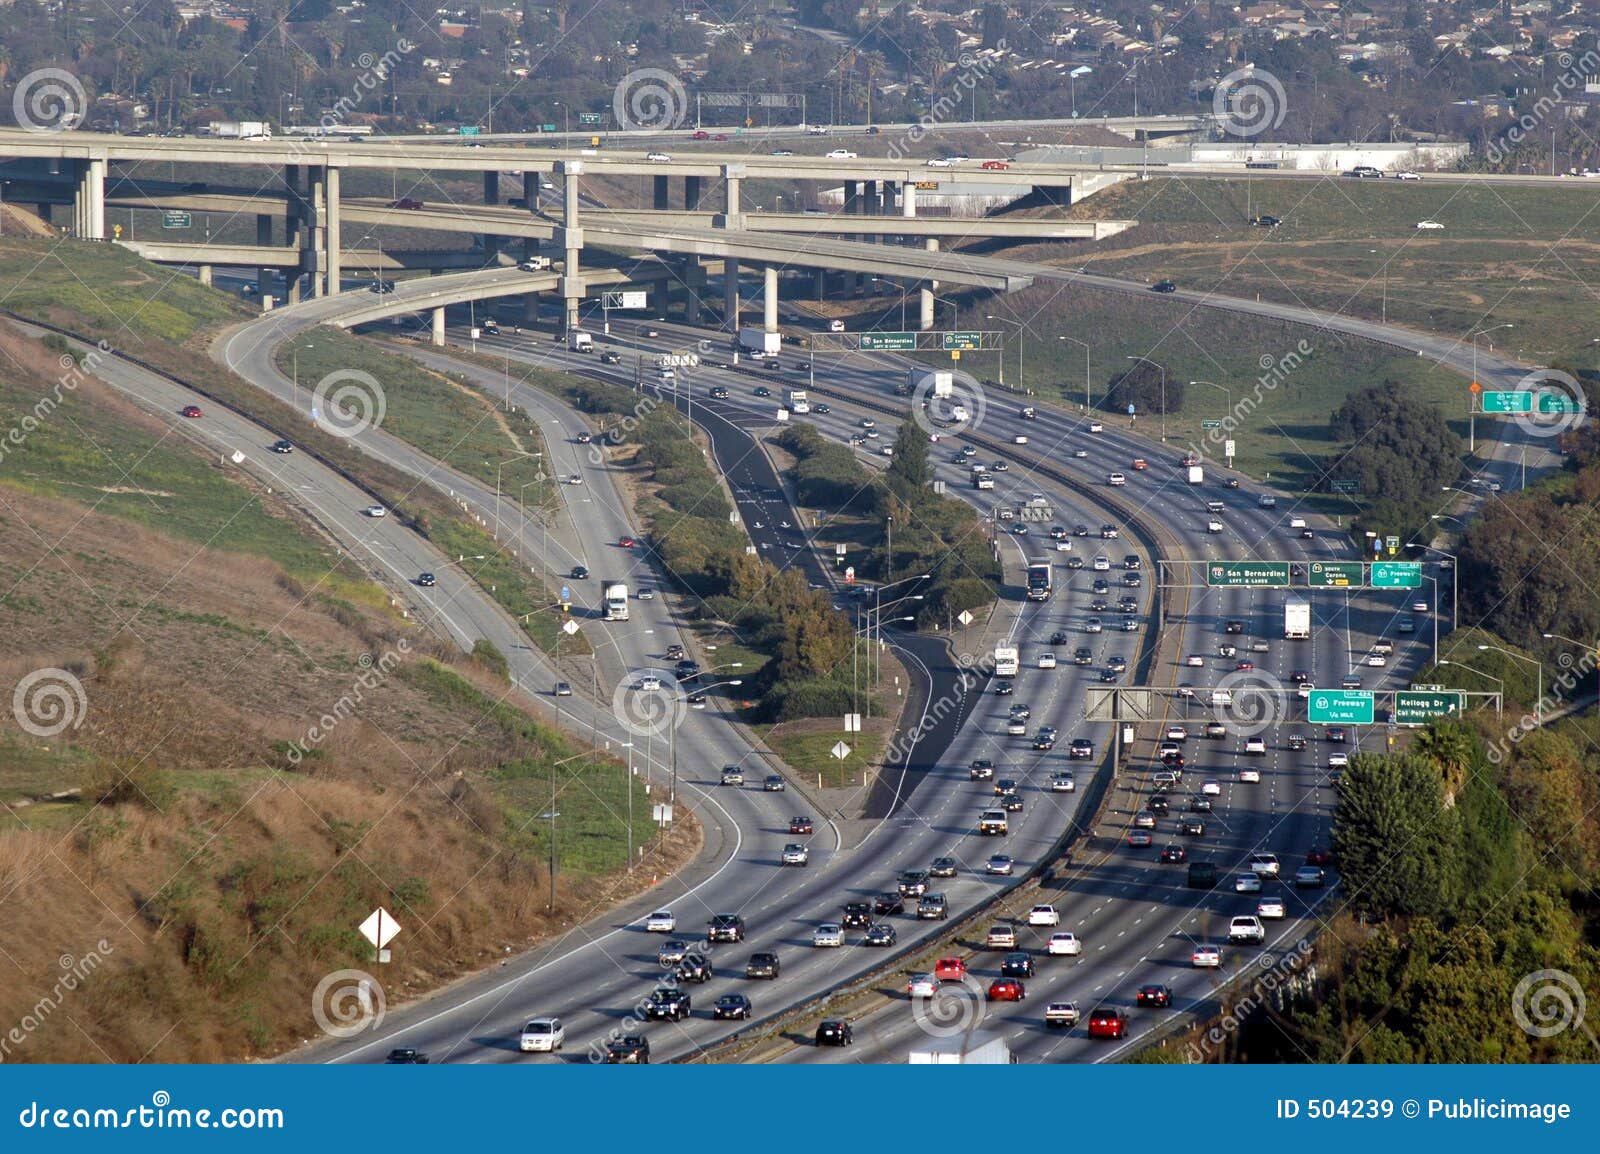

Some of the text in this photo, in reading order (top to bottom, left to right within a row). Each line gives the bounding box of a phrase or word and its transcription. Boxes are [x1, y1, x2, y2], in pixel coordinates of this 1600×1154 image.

[1244, 569, 1286, 577] Bernardino
[1333, 699, 1365, 708] Freeway
[1400, 699, 1444, 708] Kellogg Dr
[1340, 711, 1354, 719] MILE
[1410, 709, 1426, 718] Poly
